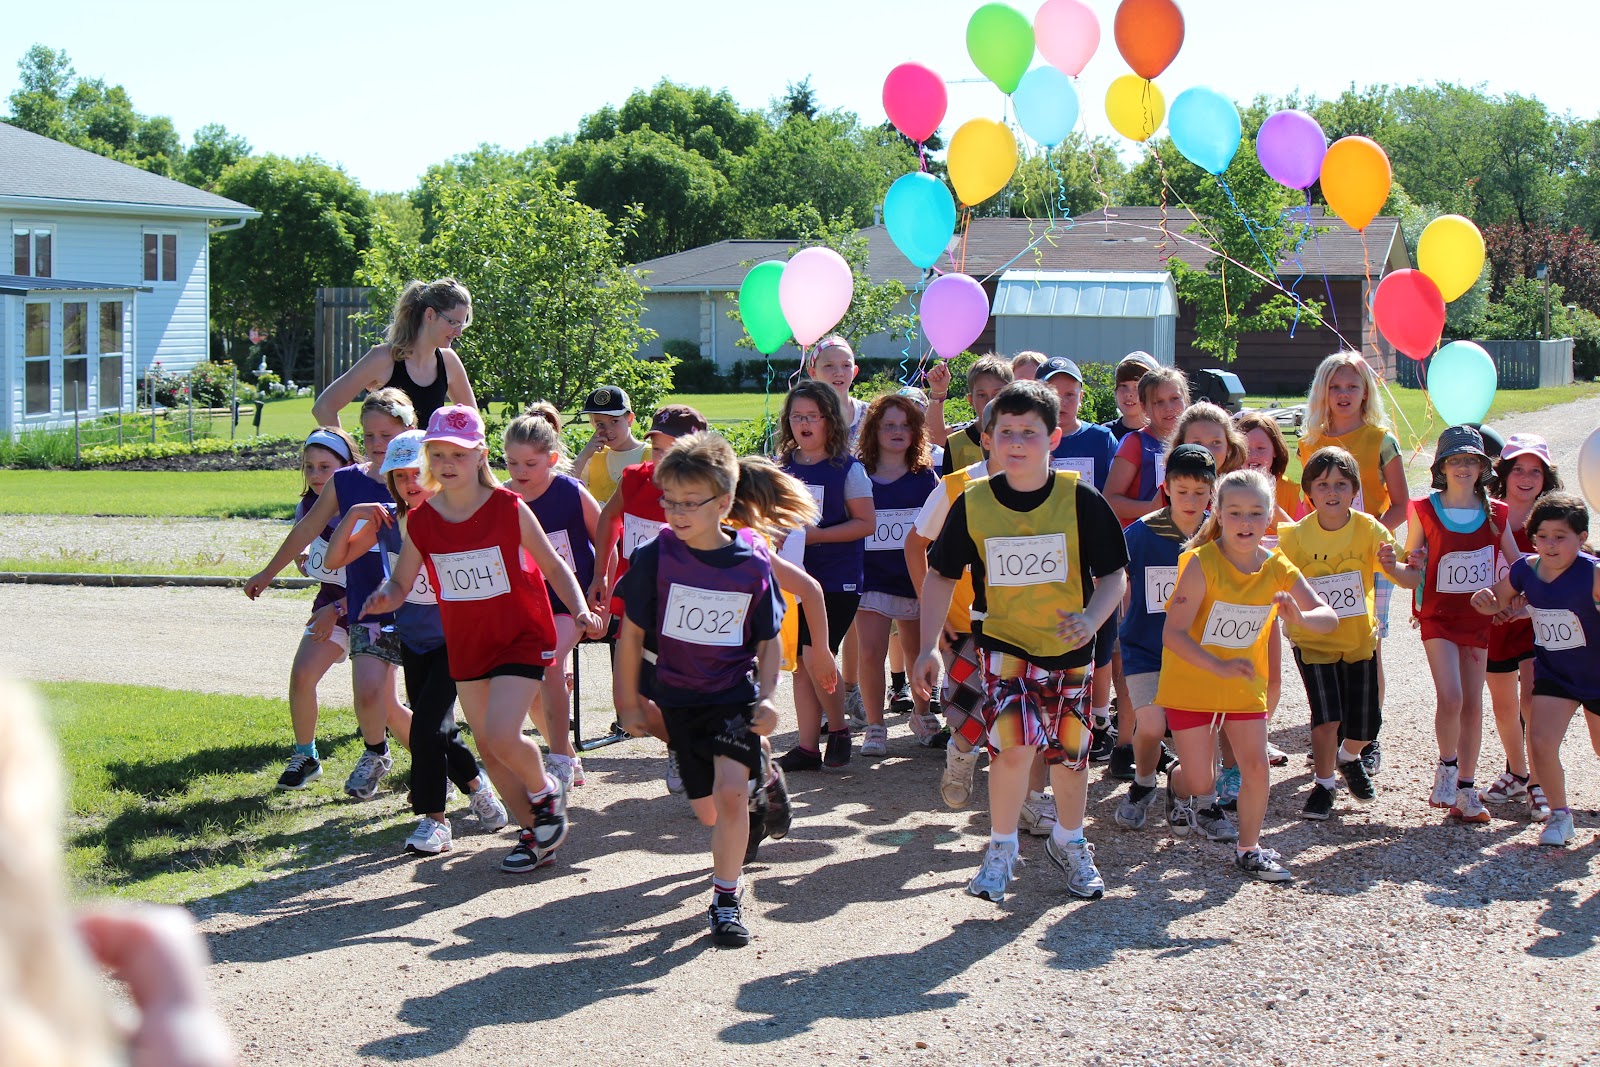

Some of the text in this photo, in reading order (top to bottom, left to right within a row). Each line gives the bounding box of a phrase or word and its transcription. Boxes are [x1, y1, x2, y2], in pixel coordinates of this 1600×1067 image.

[997, 552, 1056, 576] 1026
[1448, 562, 1487, 584] 1033
[447, 566, 493, 590] 1014
[676, 605, 734, 634] 1032
[1211, 617, 1262, 640] 1004
